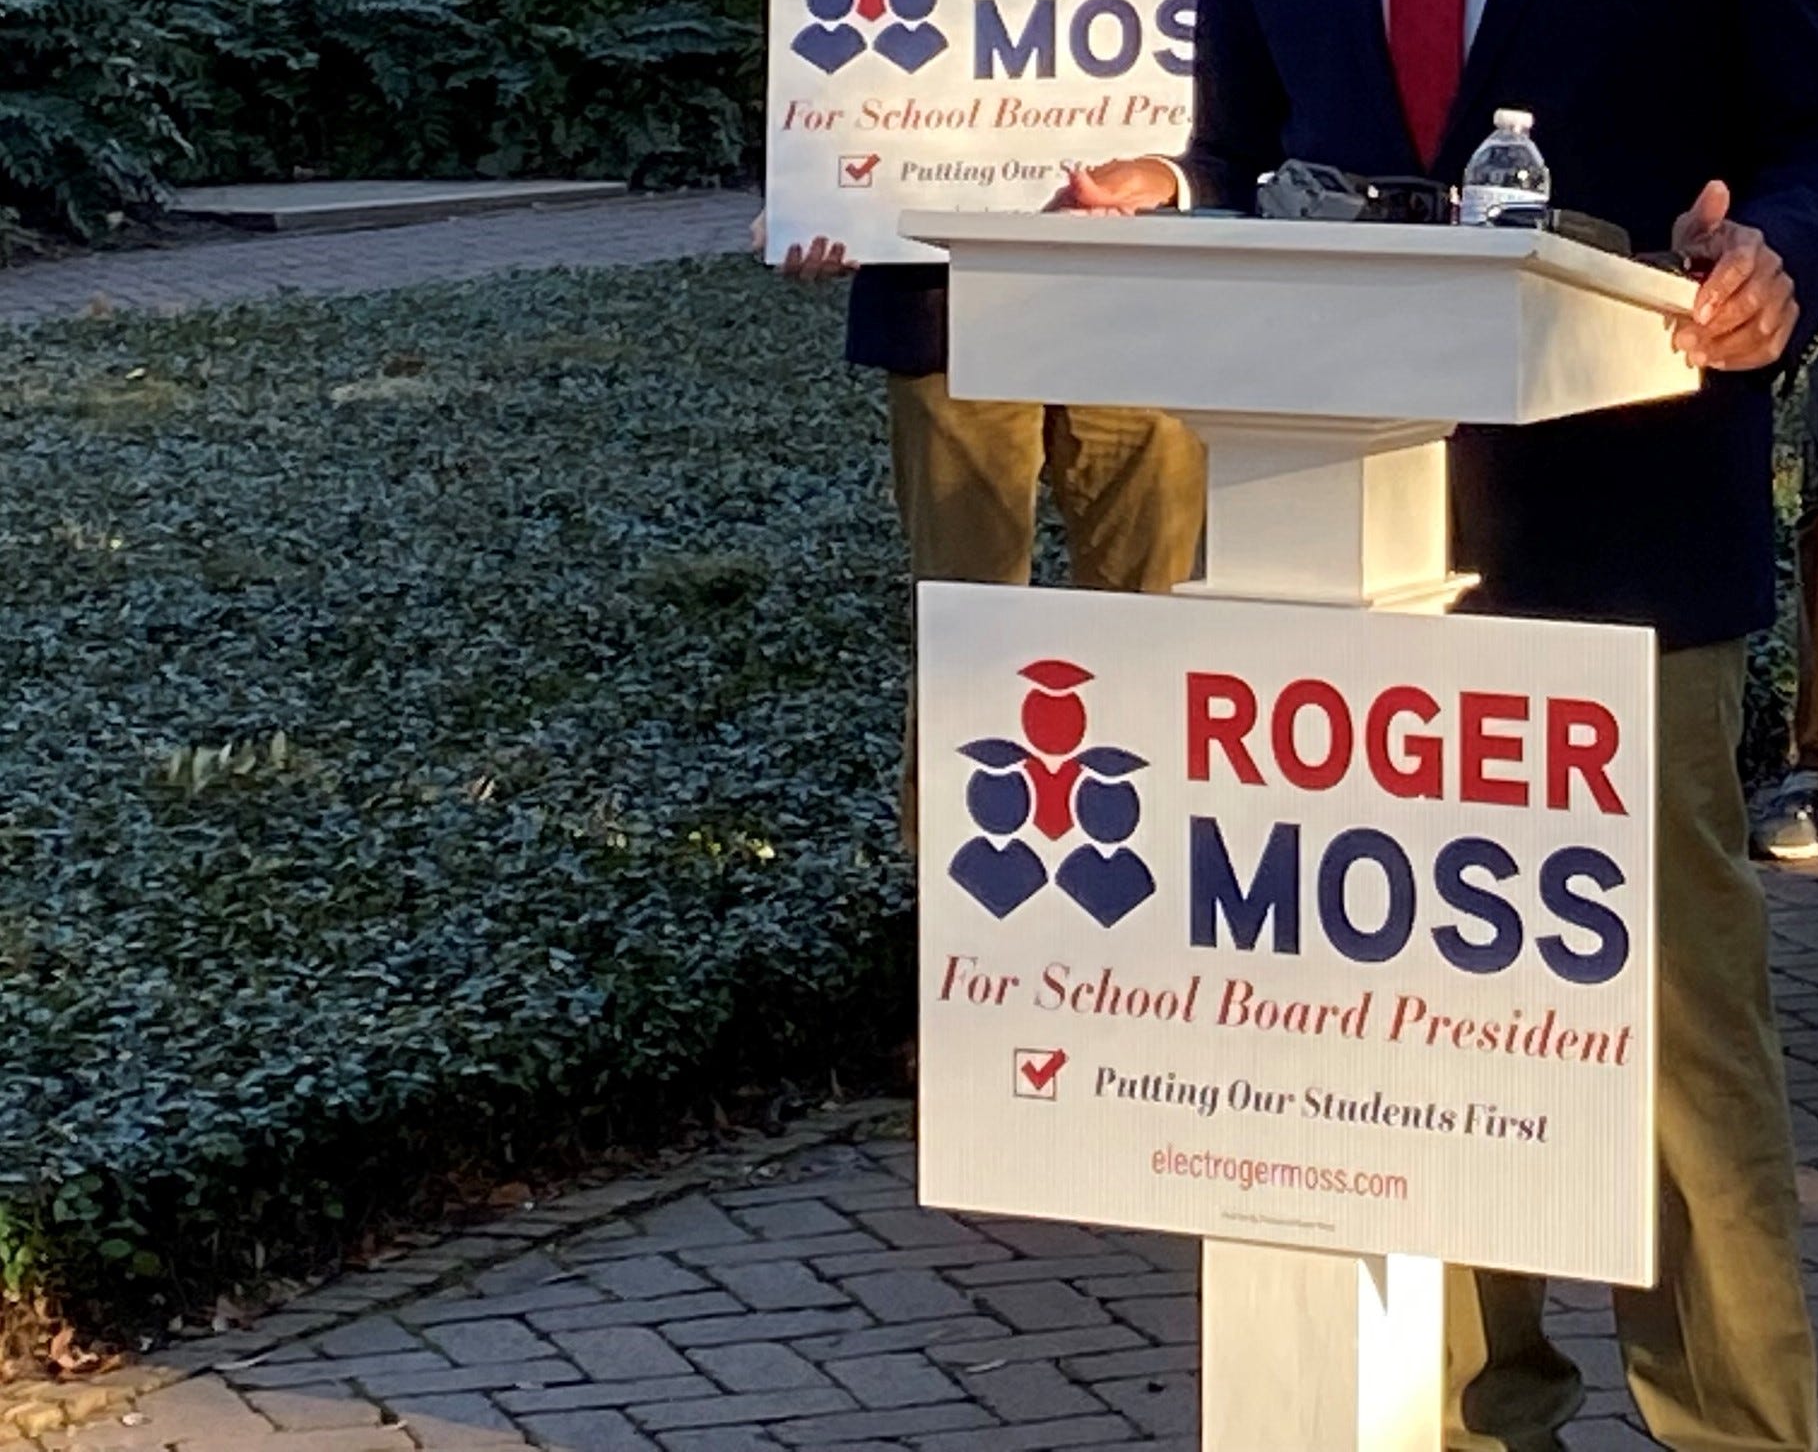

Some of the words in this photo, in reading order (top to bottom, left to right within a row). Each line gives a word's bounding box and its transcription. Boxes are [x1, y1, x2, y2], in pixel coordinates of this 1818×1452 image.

[781, 99, 844, 132] For
[856, 97, 982, 131] School
[993, 95, 1112, 129] Board
[901, 160, 996, 187] Putting
[1001, 159, 1055, 182] Our
[1185, 671, 1629, 817] ROGER
[1188, 814, 1631, 985] MOSS
[937, 954, 1020, 1006] For
[1034, 961, 1202, 1023] School
[1216, 978, 1373, 1040] Board
[1387, 994, 1635, 1068] President
[1094, 1065, 1220, 1116] Putting
[1226, 1078, 1296, 1116] Our
[1300, 1085, 1456, 1133] Students
[1463, 1102, 1550, 1144] First
[1151, 1141, 1409, 1199] electrogermoss.com
